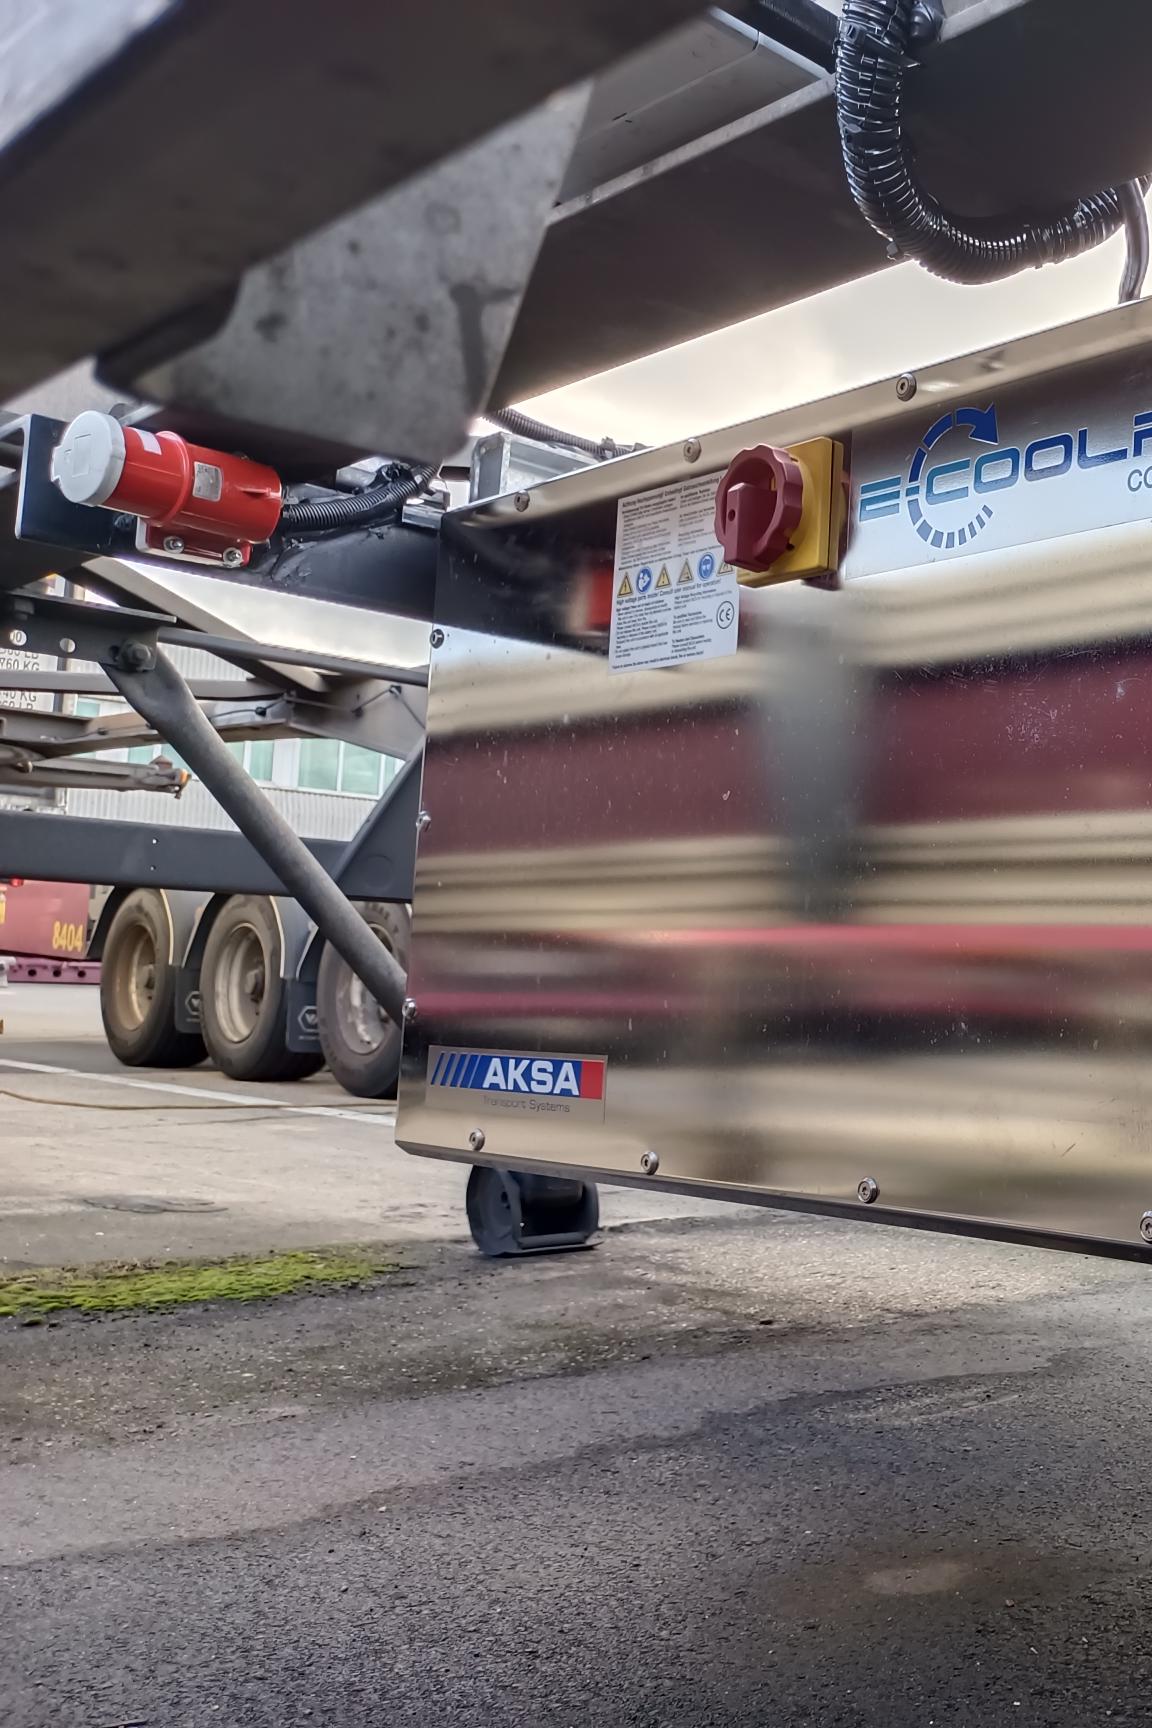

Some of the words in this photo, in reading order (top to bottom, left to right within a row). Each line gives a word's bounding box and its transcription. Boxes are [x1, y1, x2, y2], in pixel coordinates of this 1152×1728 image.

[52, 920, 84, 952] 8404
[482, 1057, 580, 1096] AKSA
[482, 1095, 526, 1110] Transport
[529, 1098, 570, 1113] Systems
